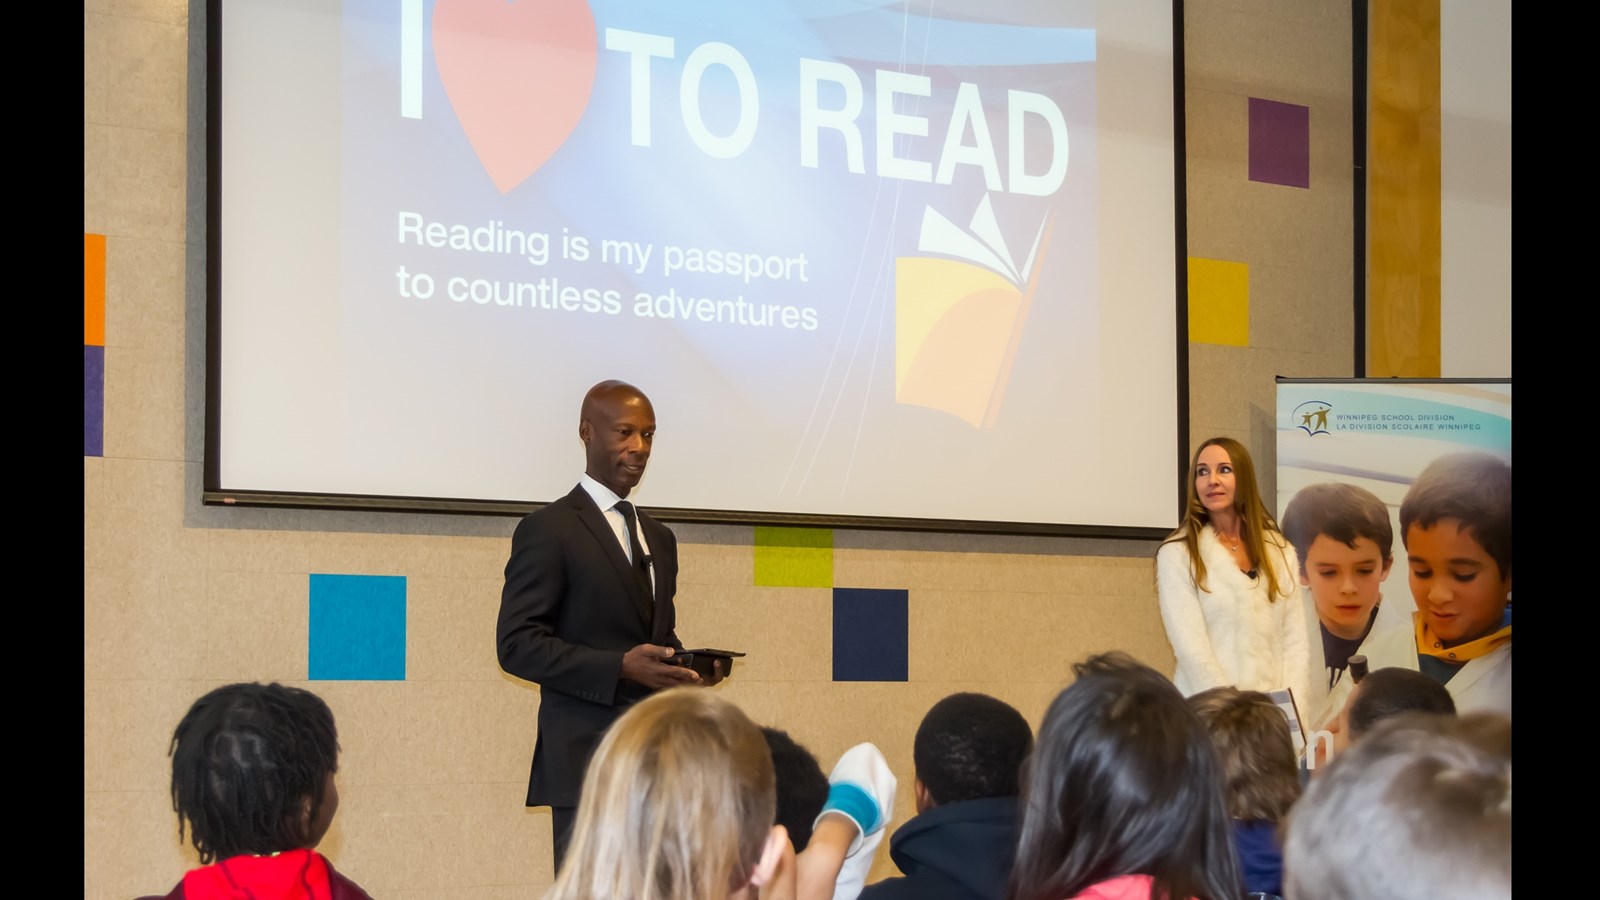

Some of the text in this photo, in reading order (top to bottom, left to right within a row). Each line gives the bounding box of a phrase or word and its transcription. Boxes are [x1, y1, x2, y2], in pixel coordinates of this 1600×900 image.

[400, 0, 1070, 198] I TO READ
[398, 211, 809, 284] Reading is my passport
[395, 265, 818, 331] to countless adventures
